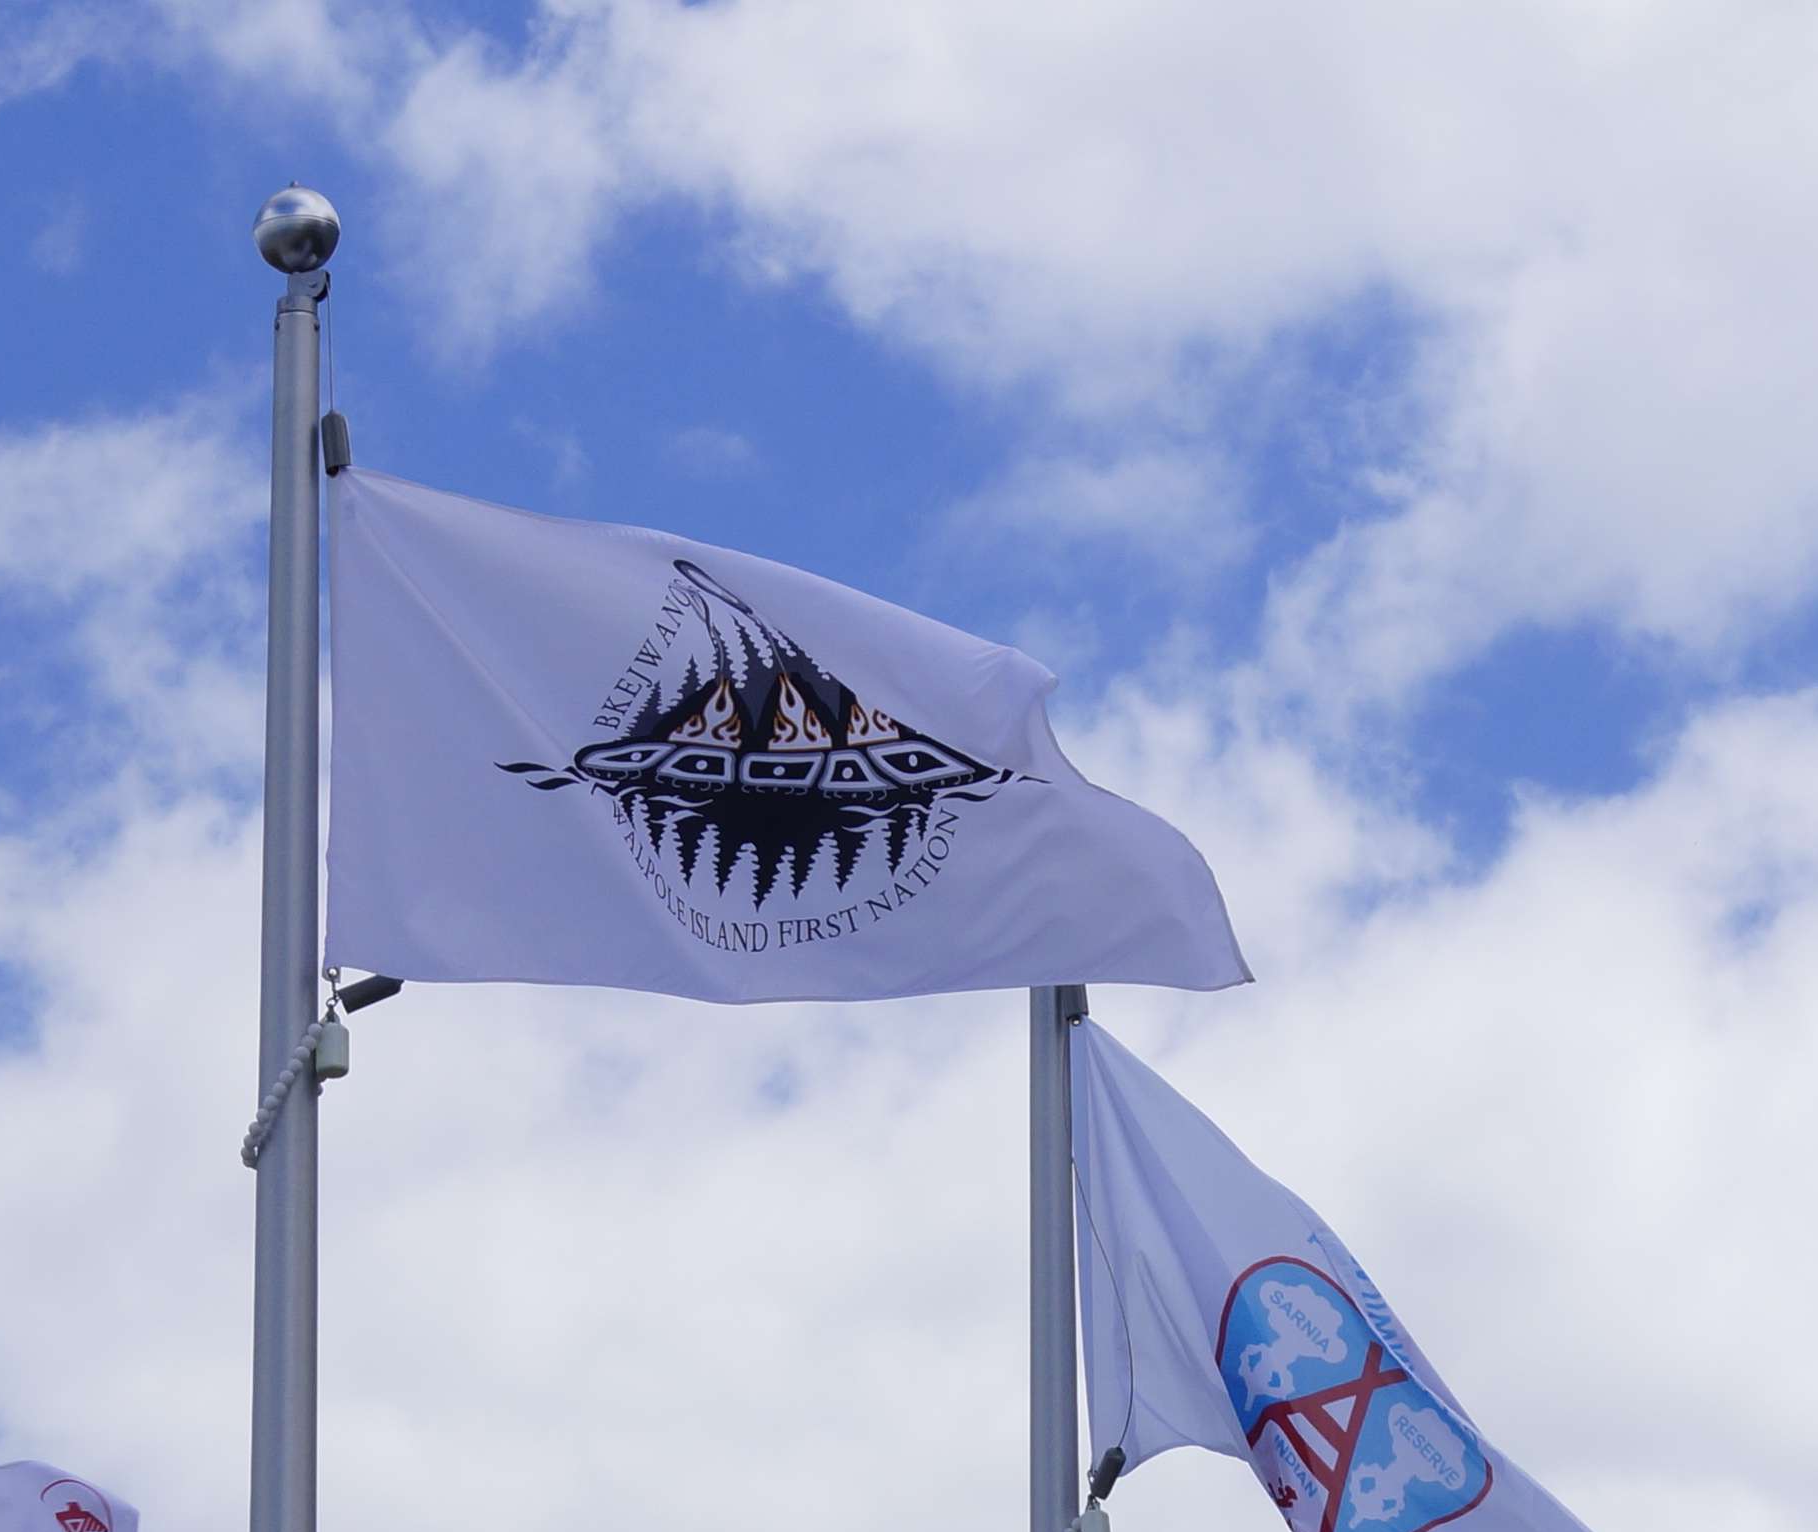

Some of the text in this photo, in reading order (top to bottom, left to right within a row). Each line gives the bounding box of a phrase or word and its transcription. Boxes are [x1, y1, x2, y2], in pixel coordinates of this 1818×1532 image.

[689, 908, 768, 953] ISLAND
[777, 906, 860, 948] FIRST
[865, 806, 961, 922] NATION
[1268, 1288, 1331, 1354] SARNIA
[1273, 1433, 1319, 1498] INDIAN
[1393, 1415, 1460, 1487] RESERVE
